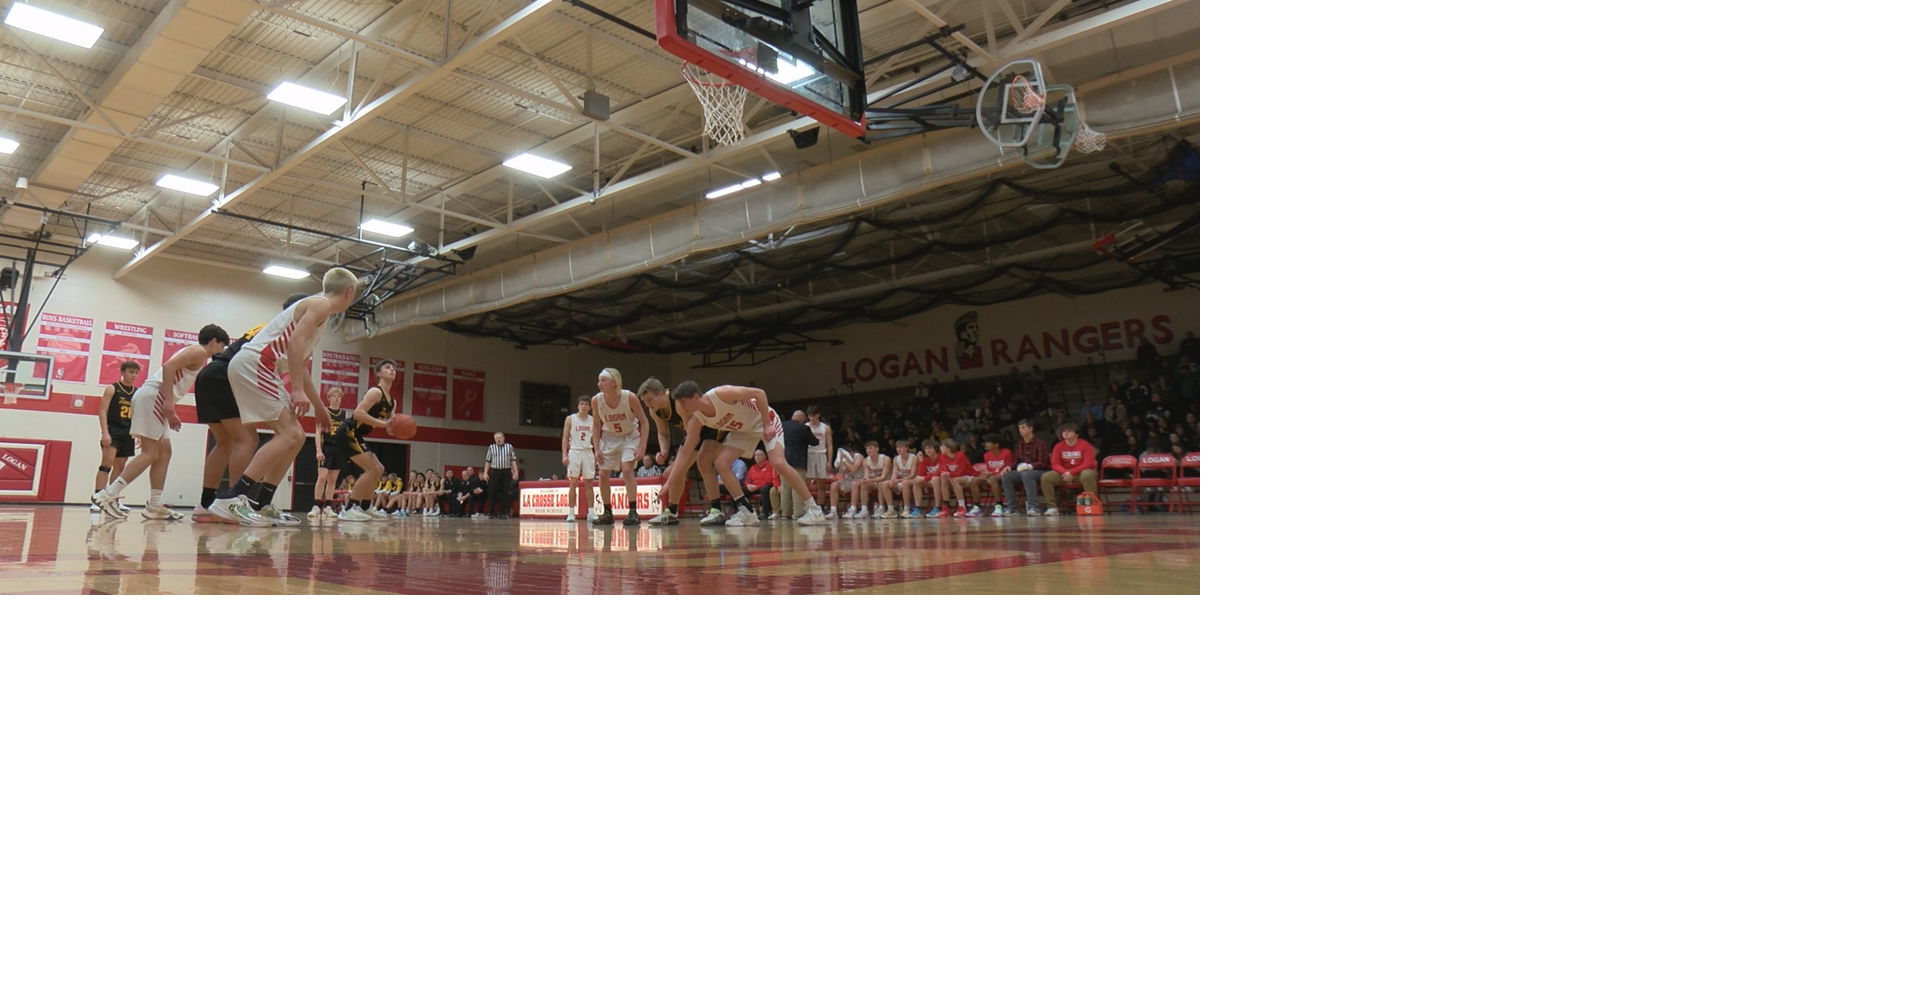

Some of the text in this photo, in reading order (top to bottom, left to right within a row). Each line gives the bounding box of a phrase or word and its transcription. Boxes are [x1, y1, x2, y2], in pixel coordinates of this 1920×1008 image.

[42, 314, 93, 326] BOYS BASKETBALL
[114, 323, 147, 334] WRESTLING
[172, 331, 200, 341] SOFTBAL
[841, 315, 1176, 385] LOGAN RANGERS
[604, 412, 627, 422] LOGAN
[713, 412, 735, 429] LOGAN
[613, 423, 623, 433] 5
[725, 420, 744, 431] 15
[580, 432, 586, 441] 2
[2, 453, 28, 471] LOGAN
[1142, 456, 1171, 464] LOGAN
[523, 494, 531, 508] LA
[532, 494, 555, 508] CROSSE
